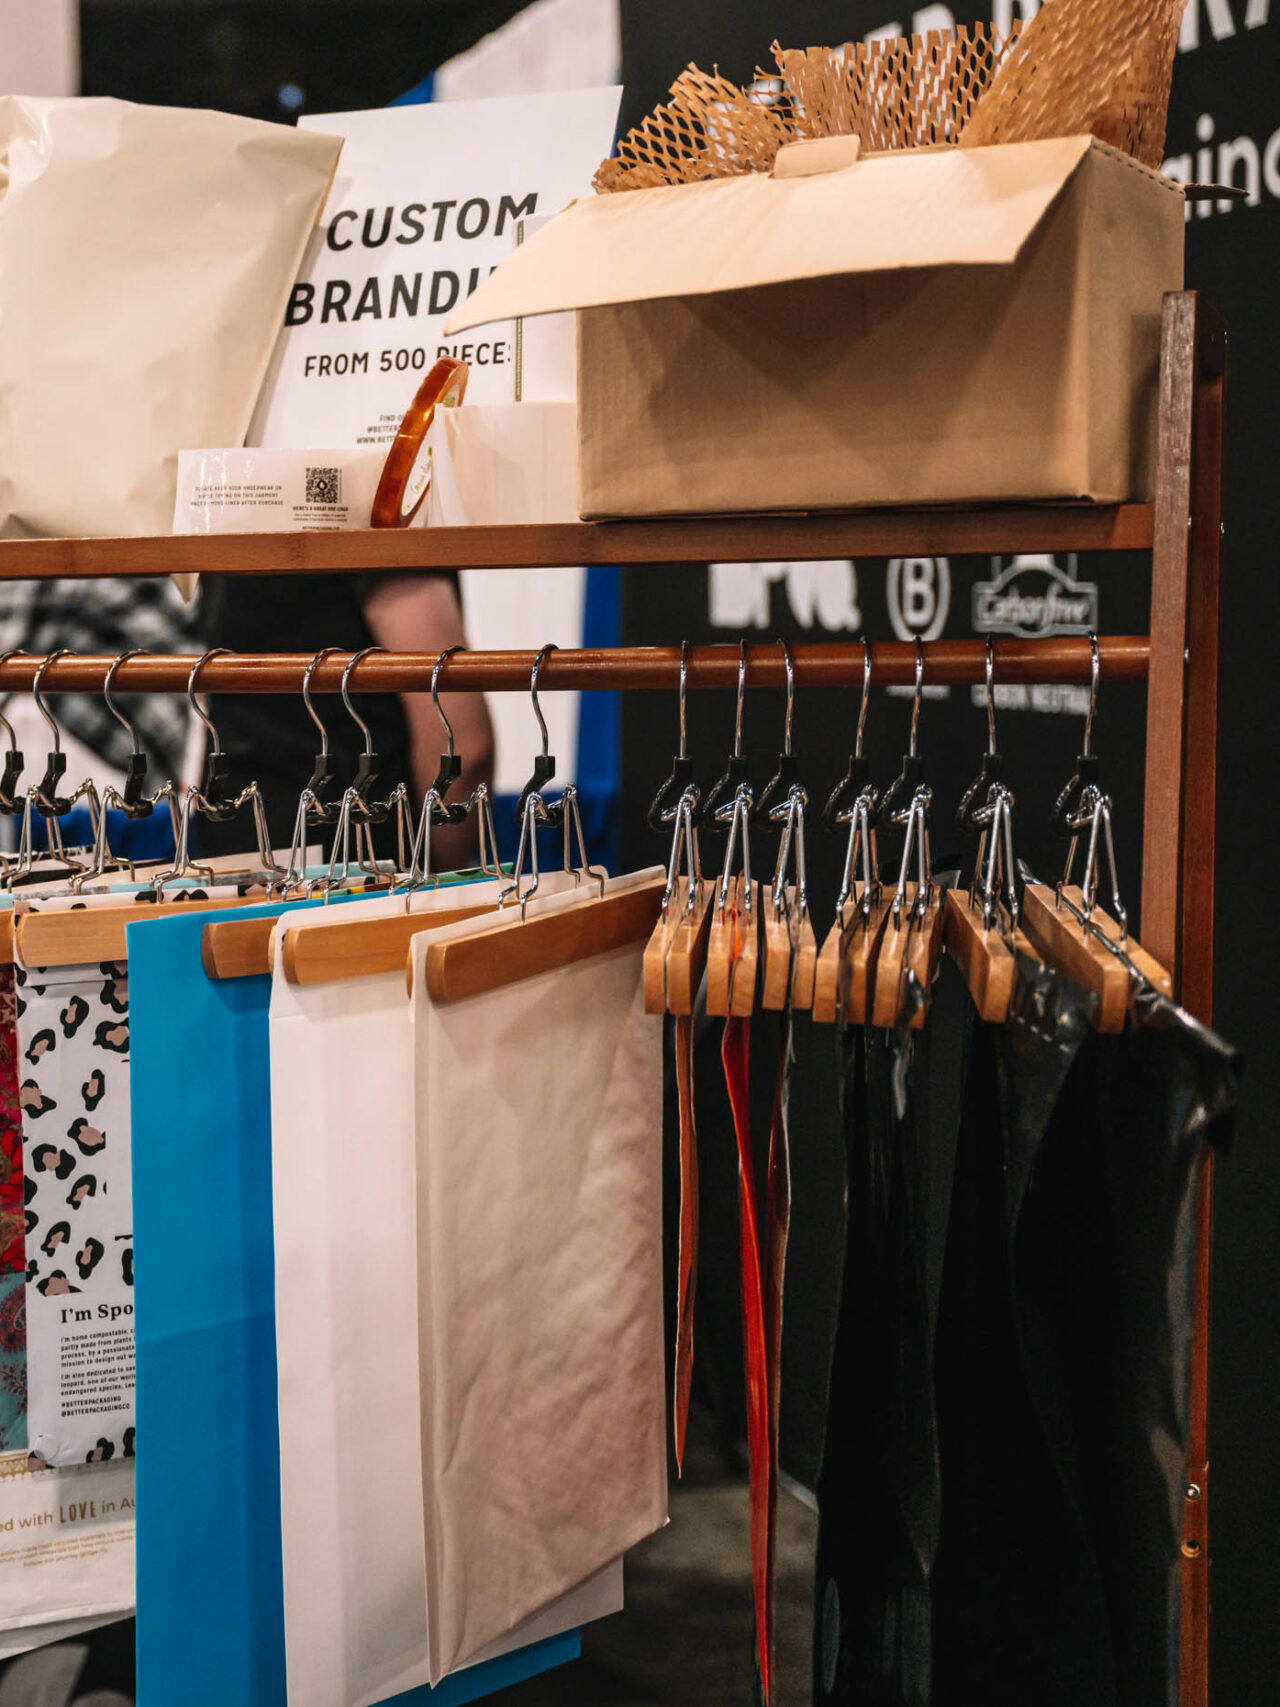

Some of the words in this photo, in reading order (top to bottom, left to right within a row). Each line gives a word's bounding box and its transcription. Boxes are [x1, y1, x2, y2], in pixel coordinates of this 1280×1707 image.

[326, 192, 539, 252] CUSTOM
[284, 265, 498, 328] BRANDI
[304, 352, 370, 378] FROM
[380, 347, 426, 373] 500
[98, 1304, 133, 1321] Spo
[18, 1512, 54, 1529] with
[59, 1501, 97, 1524] LOVE
[102, 1502, 115, 1513] in
